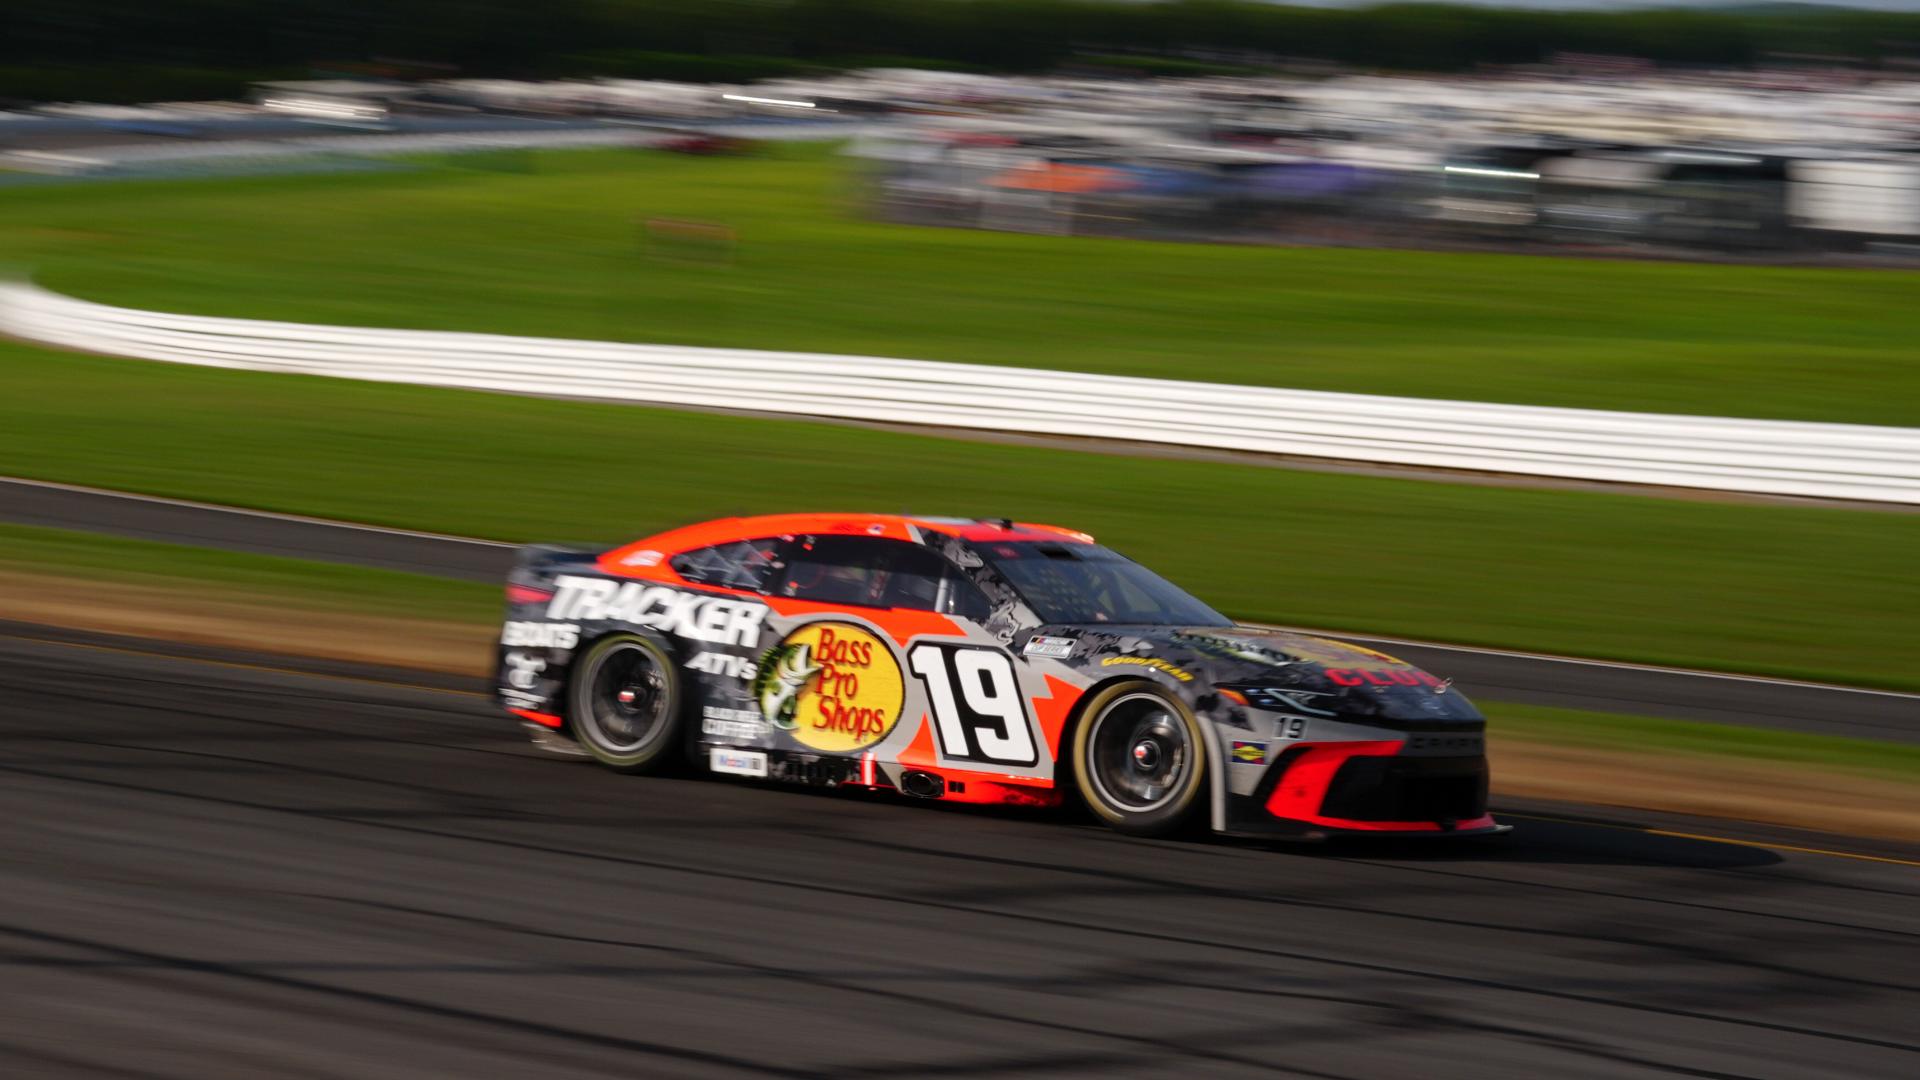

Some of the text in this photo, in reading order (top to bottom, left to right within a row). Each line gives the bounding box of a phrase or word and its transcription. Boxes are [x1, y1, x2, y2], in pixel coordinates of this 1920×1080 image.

[546, 574, 771, 649] TRACKER
[501, 621, 581, 650] BOATS
[816, 627, 872, 669] Bass
[815, 662, 859, 700] Pro
[813, 695, 885, 741] Shops
[908, 641, 1039, 766] 19
[1277, 717, 1304, 739] 19
